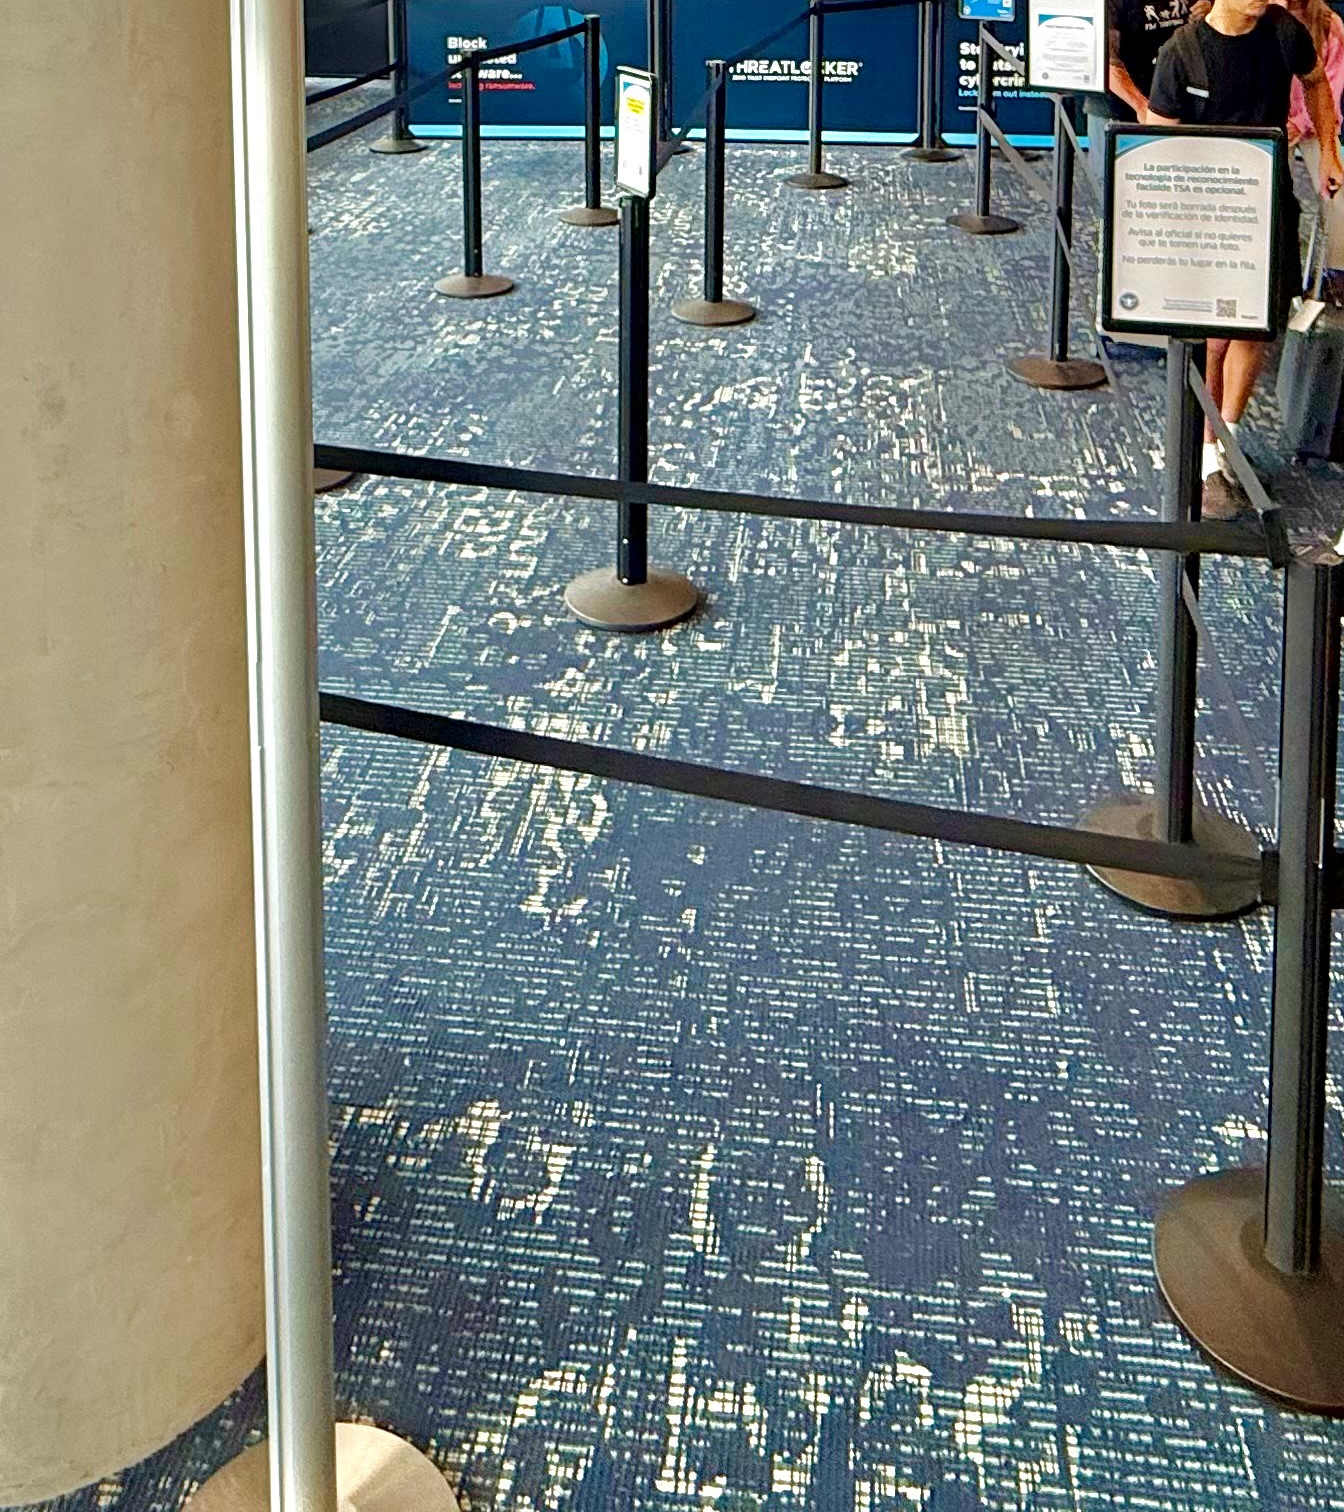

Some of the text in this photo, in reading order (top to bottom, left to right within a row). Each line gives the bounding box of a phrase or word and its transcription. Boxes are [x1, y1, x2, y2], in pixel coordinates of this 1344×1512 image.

[447, 36, 487, 49] Block
[728, 59, 859, 75] HREATLOKER
[959, 58, 976, 70] to
[1144, 163, 1154, 171] La
[1174, 184, 1190, 192] TSA
[1205, 186, 1246, 196] opcional.
[1126, 200, 1137, 208] Tu
[1139, 200, 1156, 209] foto
[1180, 202, 1216, 212] borrada
[1122, 210, 1133, 219] de
[1135, 210, 1143, 219] la
[1200, 214, 1212, 222] de
[1128, 228, 1153, 236] Avisa
[1155, 229, 1163, 237] al
[1195, 230, 1202, 239] si
[1139, 239, 1240, 251] que te tomen una foto.
[1122, 256, 1135, 264] No
[1179, 258, 1188, 266] tu
[1190, 258, 1214, 268] lugar
[1229, 260, 1238, 269] la
